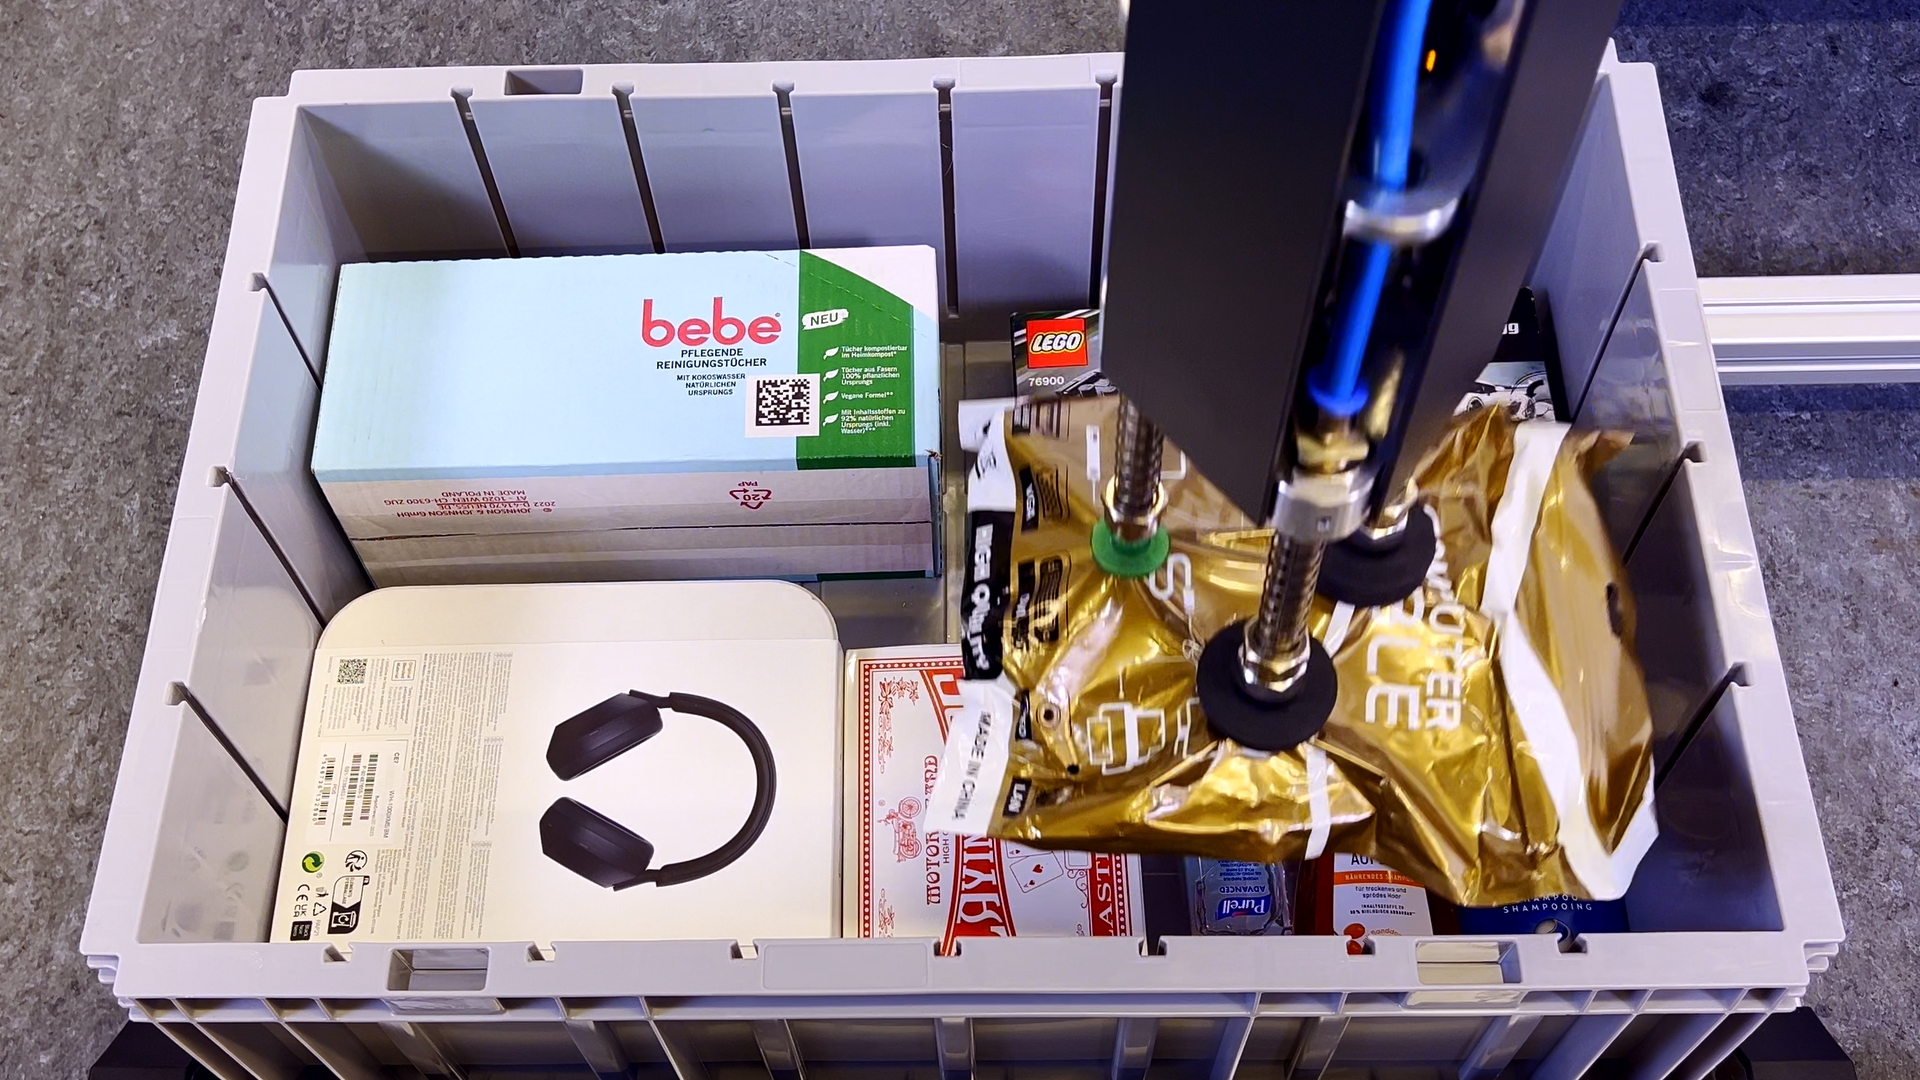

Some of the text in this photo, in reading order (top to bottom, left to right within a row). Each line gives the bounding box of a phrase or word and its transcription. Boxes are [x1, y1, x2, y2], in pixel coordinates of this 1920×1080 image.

[810, 312, 839, 327] NEU
[1031, 332, 1082, 352] LEGO
[681, 348, 744, 358] PFLEGENDE
[864, 345, 908, 353] kompostierbar
[656, 358, 767, 369] REINIGUNGSTÜCHER
[692, 373, 746, 381] KOKOSWASSER
[862, 372, 900, 380] pflanzlichen
[1028, 376, 1065, 387] 76900
[688, 388, 734, 396] URSPRUNGS
[841, 392, 863, 400] Vegane
[971, 711, 992, 759] MADE
[967, 760, 981, 780] IN
[926, 831, 941, 906] MOTOR
[1219, 885, 1266, 893] ADVANCED
[1222, 899, 1266, 914] Purell
[1503, 902, 1592, 914] SHAMPOOING
